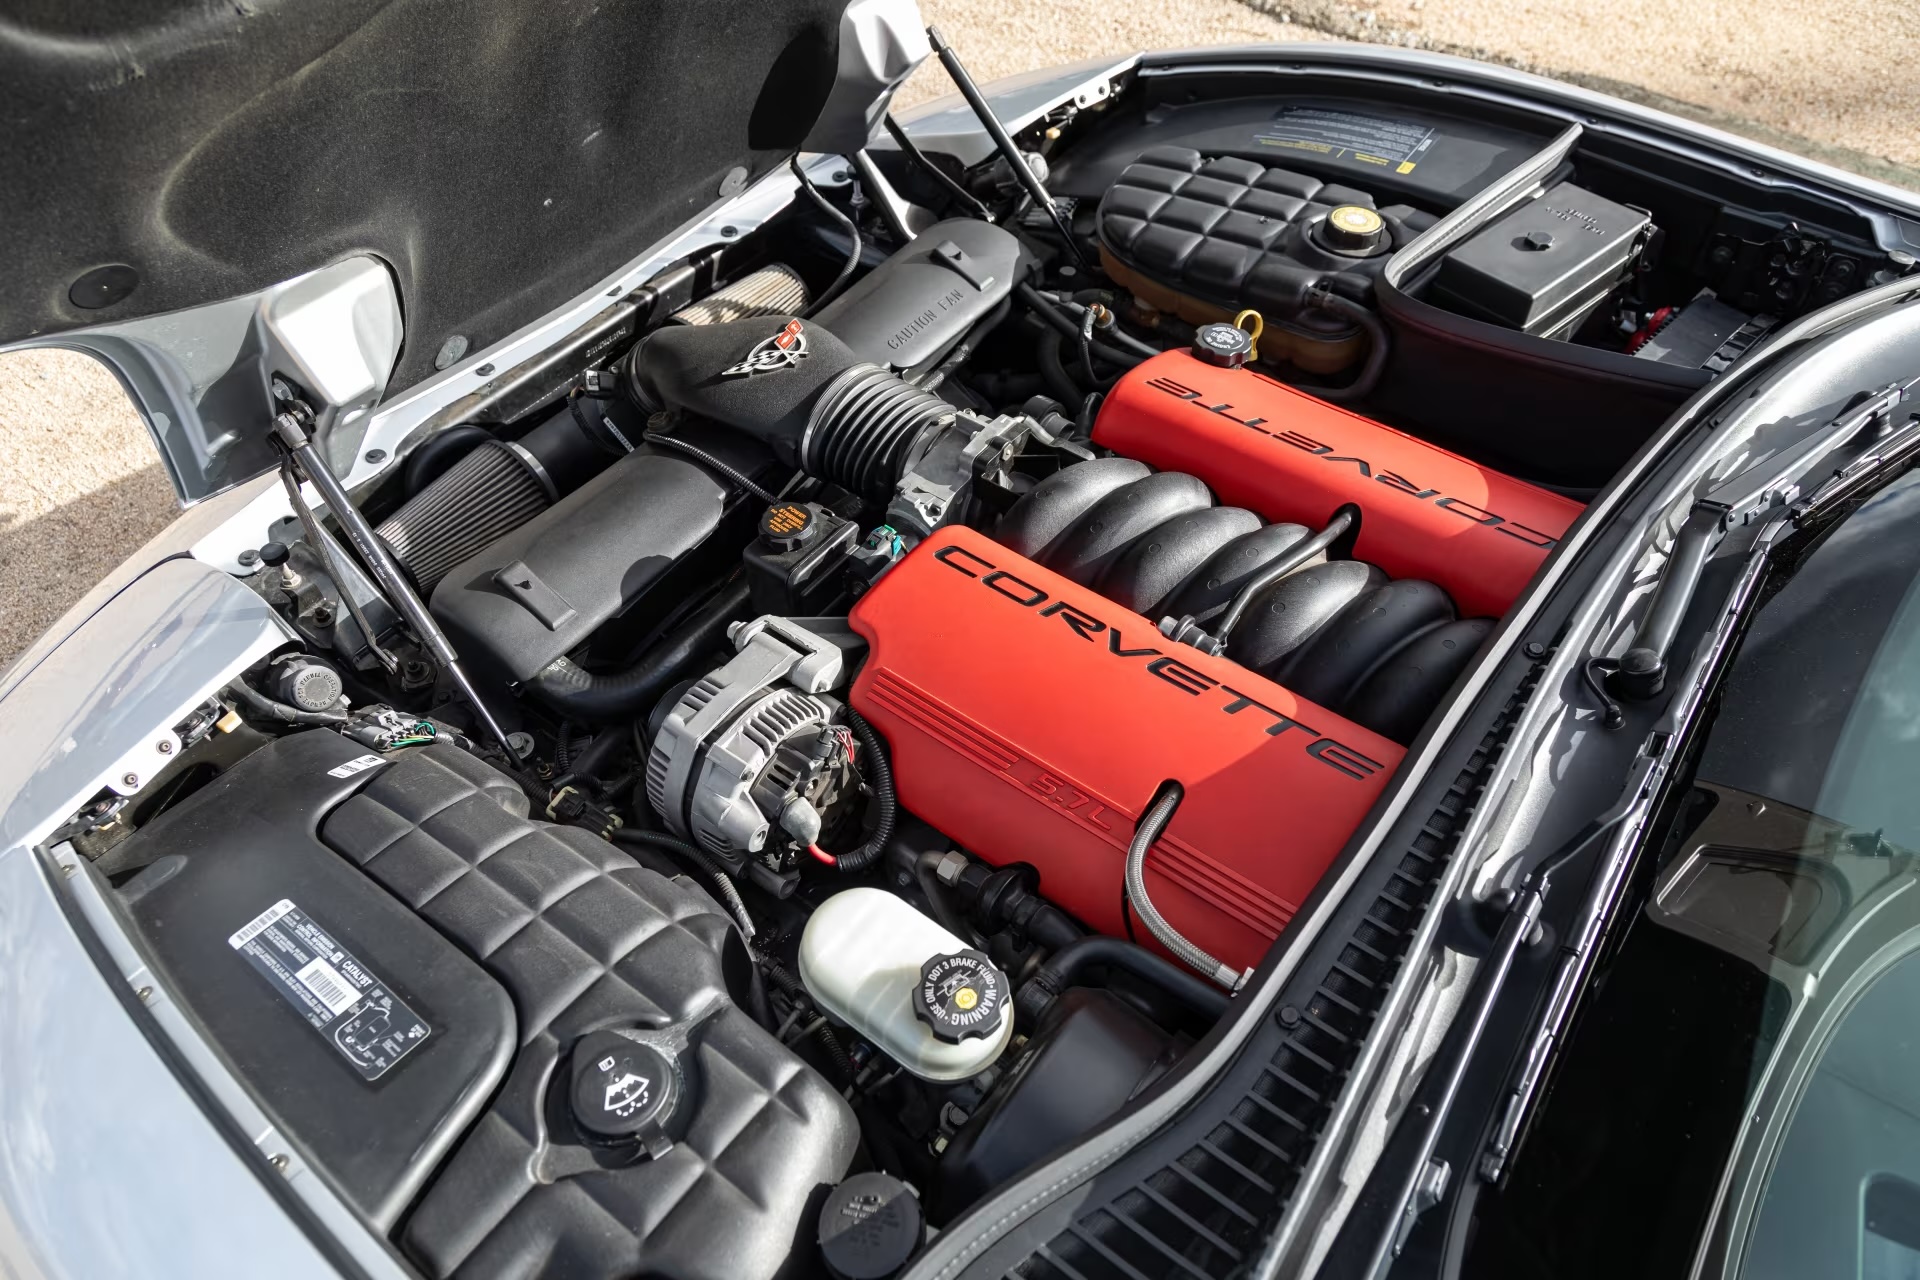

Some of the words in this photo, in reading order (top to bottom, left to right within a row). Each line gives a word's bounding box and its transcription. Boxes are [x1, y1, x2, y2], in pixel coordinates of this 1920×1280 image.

[887, 309, 938, 350] CAUTION
[937, 289, 964, 311] FAN
[1145, 377, 1560, 550] CORVETTE
[779, 508, 804, 525] STEERING
[787, 505, 807, 520] POWER
[933, 545, 1385, 781] CORVETTE
[1030, 773, 1111, 831] 5.7L
[342, 960, 373, 987] CATALYST
[928, 964, 944, 981] DOT
[942, 961, 950, 969] 3
[949, 957, 978, 969] BRAKE
[976, 964, 996, 985] FLUID
[924, 981, 936, 1003] ONLY
[930, 1002, 946, 1019] USE
[951, 989, 997, 1026] WARNING
